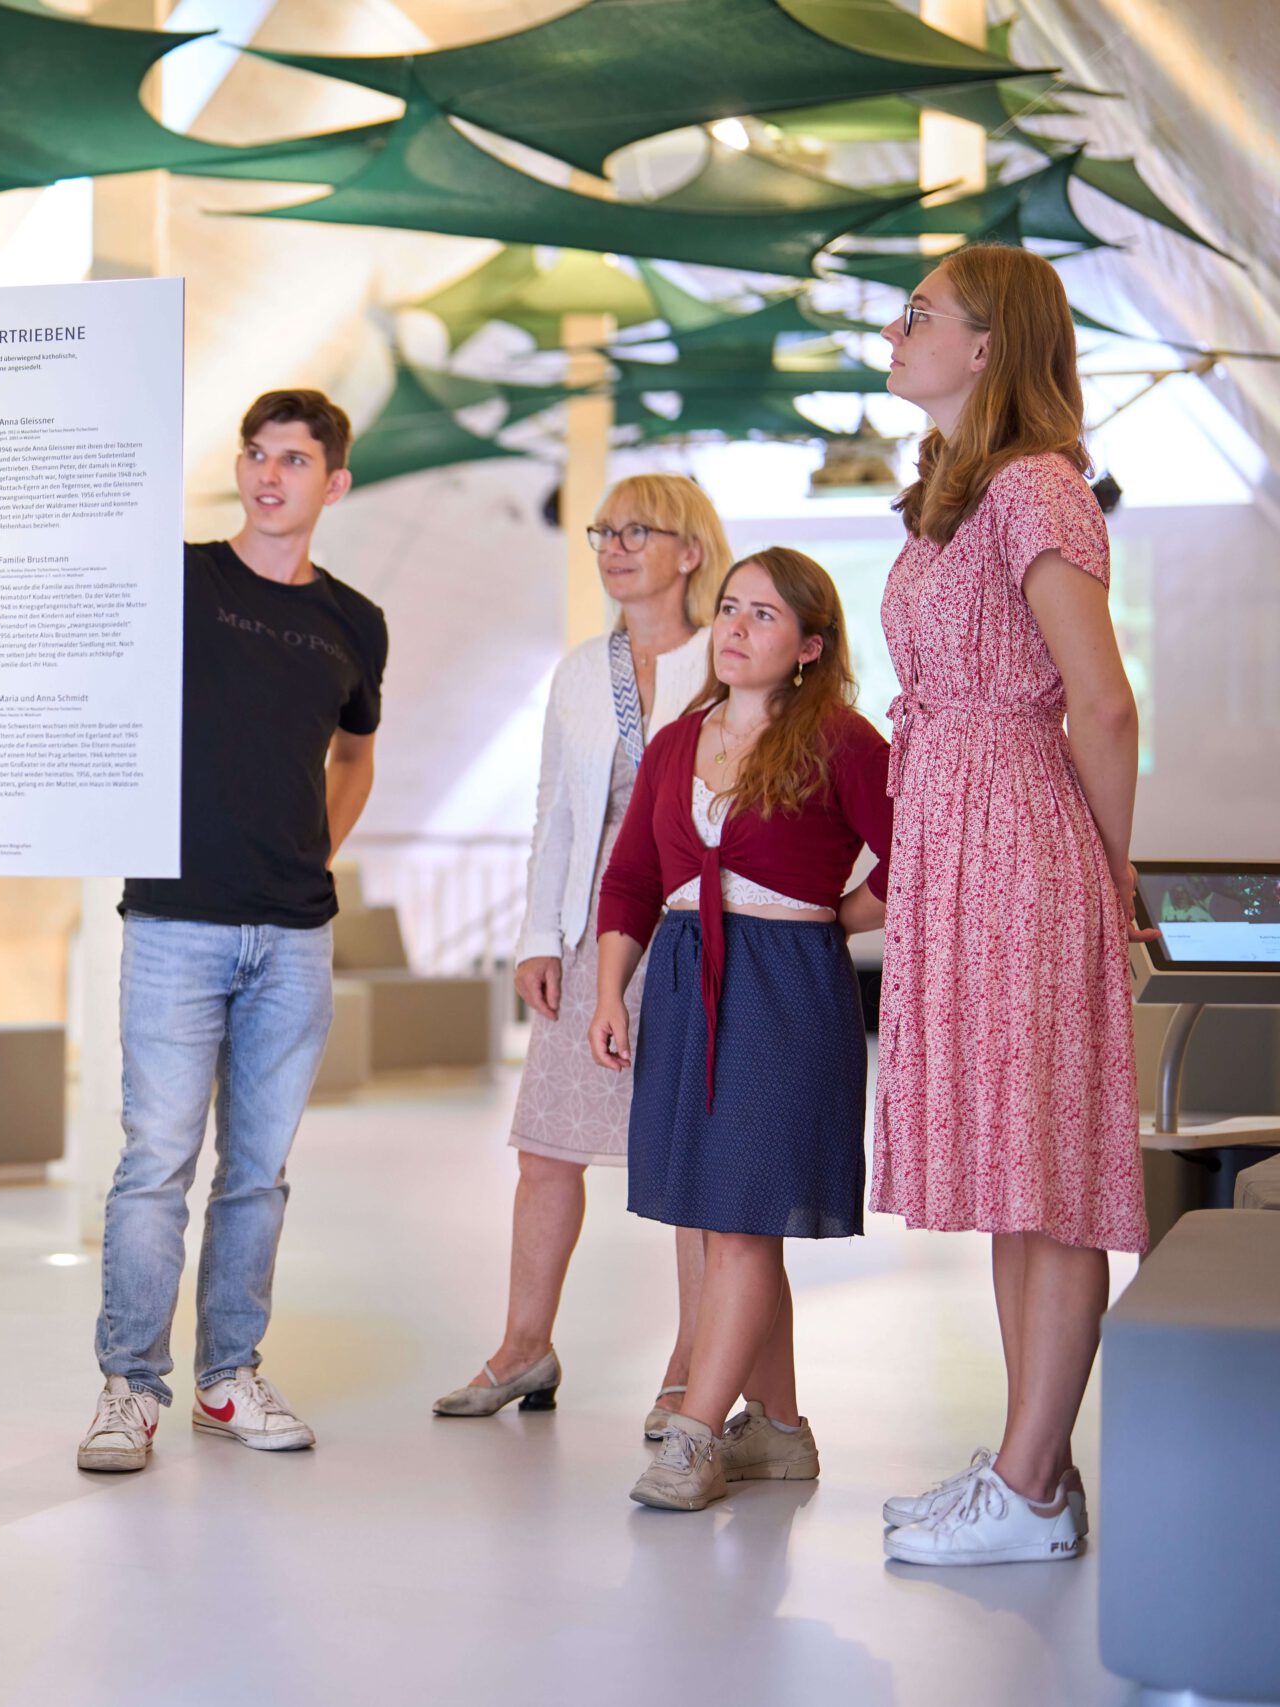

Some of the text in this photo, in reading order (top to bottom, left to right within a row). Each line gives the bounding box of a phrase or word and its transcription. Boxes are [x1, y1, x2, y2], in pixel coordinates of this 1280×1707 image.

[0, 416, 54, 426] Anna Gleissner
[27, 554, 69, 564] Brustmann
[20, 694, 36, 702] und
[36, 694, 56, 702] Anna
[57, 693, 89, 702] Schmidt
[1051, 1540, 1079, 1553] FILA
